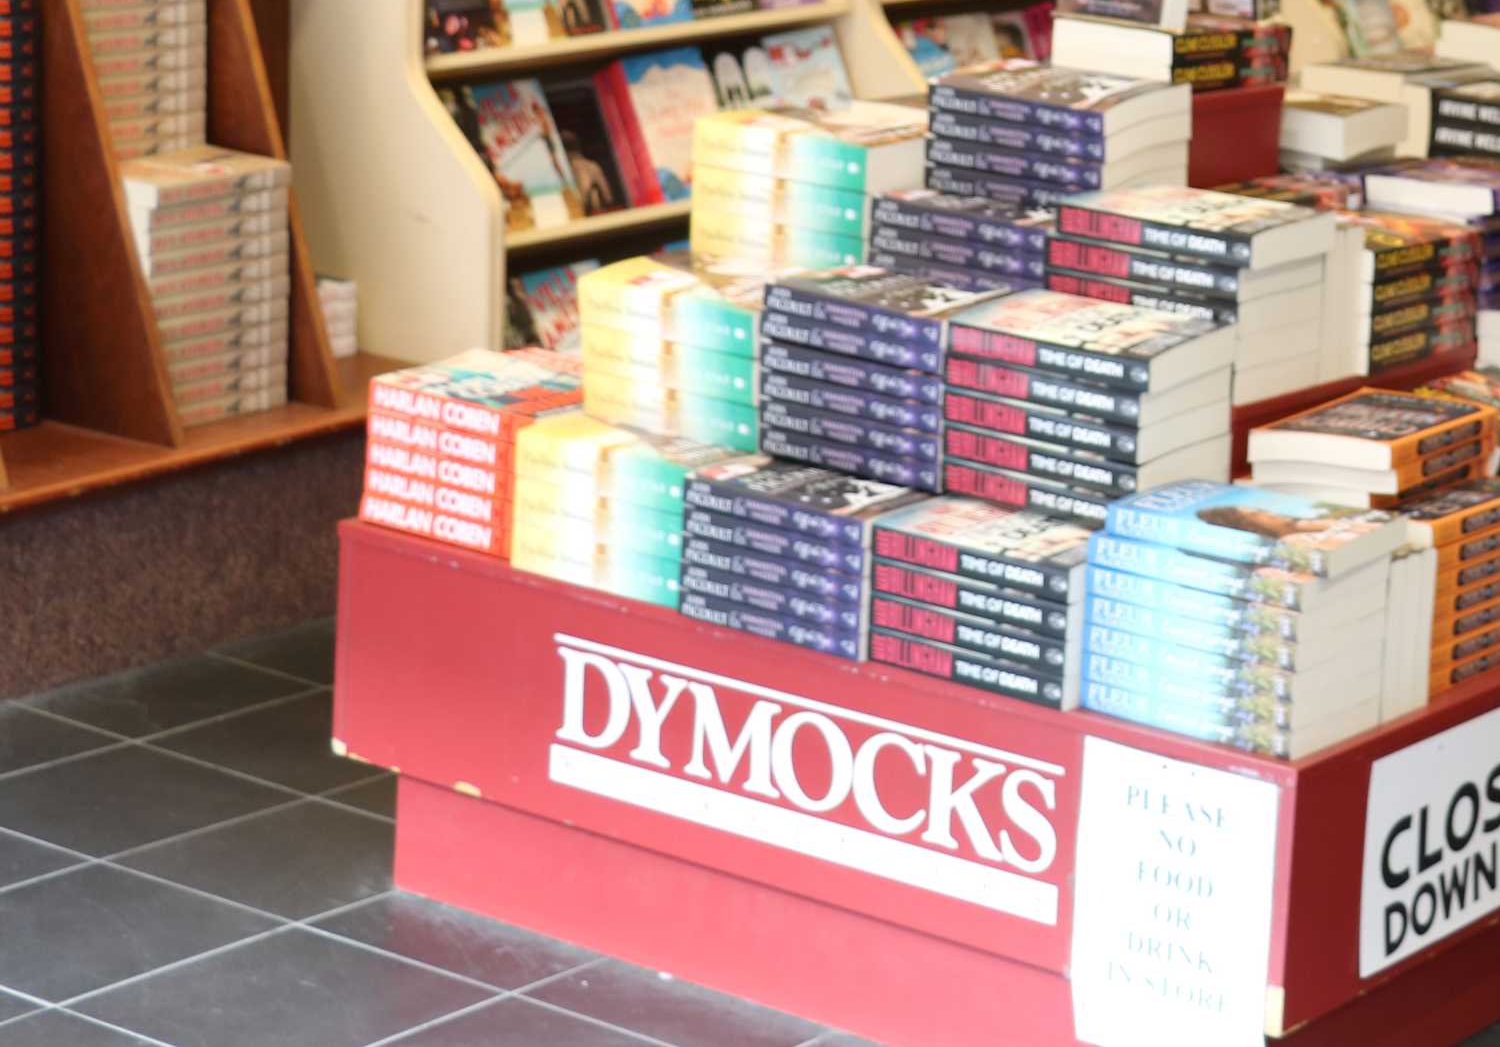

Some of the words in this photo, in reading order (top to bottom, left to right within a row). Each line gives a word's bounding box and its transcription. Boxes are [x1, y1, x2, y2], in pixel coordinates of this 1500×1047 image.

[374, 384, 438, 420] HARLAN
[442, 401, 500, 436] COBEN
[370, 414, 436, 448] HARLAN
[439, 431, 496, 464] COBEN
[370, 443, 436, 478] HARLAN
[438, 460, 496, 494] COBEN
[368, 471, 434, 505] HARLAN
[436, 487, 492, 522] COBEN
[363, 497, 433, 532] HARLAN
[434, 514, 492, 550] COBEN
[960, 554, 988, 573] TIME
[988, 561, 1004, 576] OF
[1004, 565, 1044, 587] DEATH
[959, 590, 986, 609] TIME
[986, 596, 1002, 612] OF
[1003, 601, 1042, 624] DEATH
[957, 625, 984, 644] TIME
[984, 633, 1000, 648] OF
[1001, 636, 1040, 659] DEATH
[955, 660, 982, 679] TIME
[982, 667, 998, 682] OF
[999, 671, 1038, 694] DEATH
[555, 646, 1057, 874] DYMOCKS
[1127, 785, 1229, 829] PLEASE
[1159, 829, 1197, 857] NO
[1138, 860, 1214, 898] FOOD
[1384, 840, 1497, 957] DOWN
[1153, 905, 1191, 931] OR
[1127, 931, 1213, 974] DRINK
